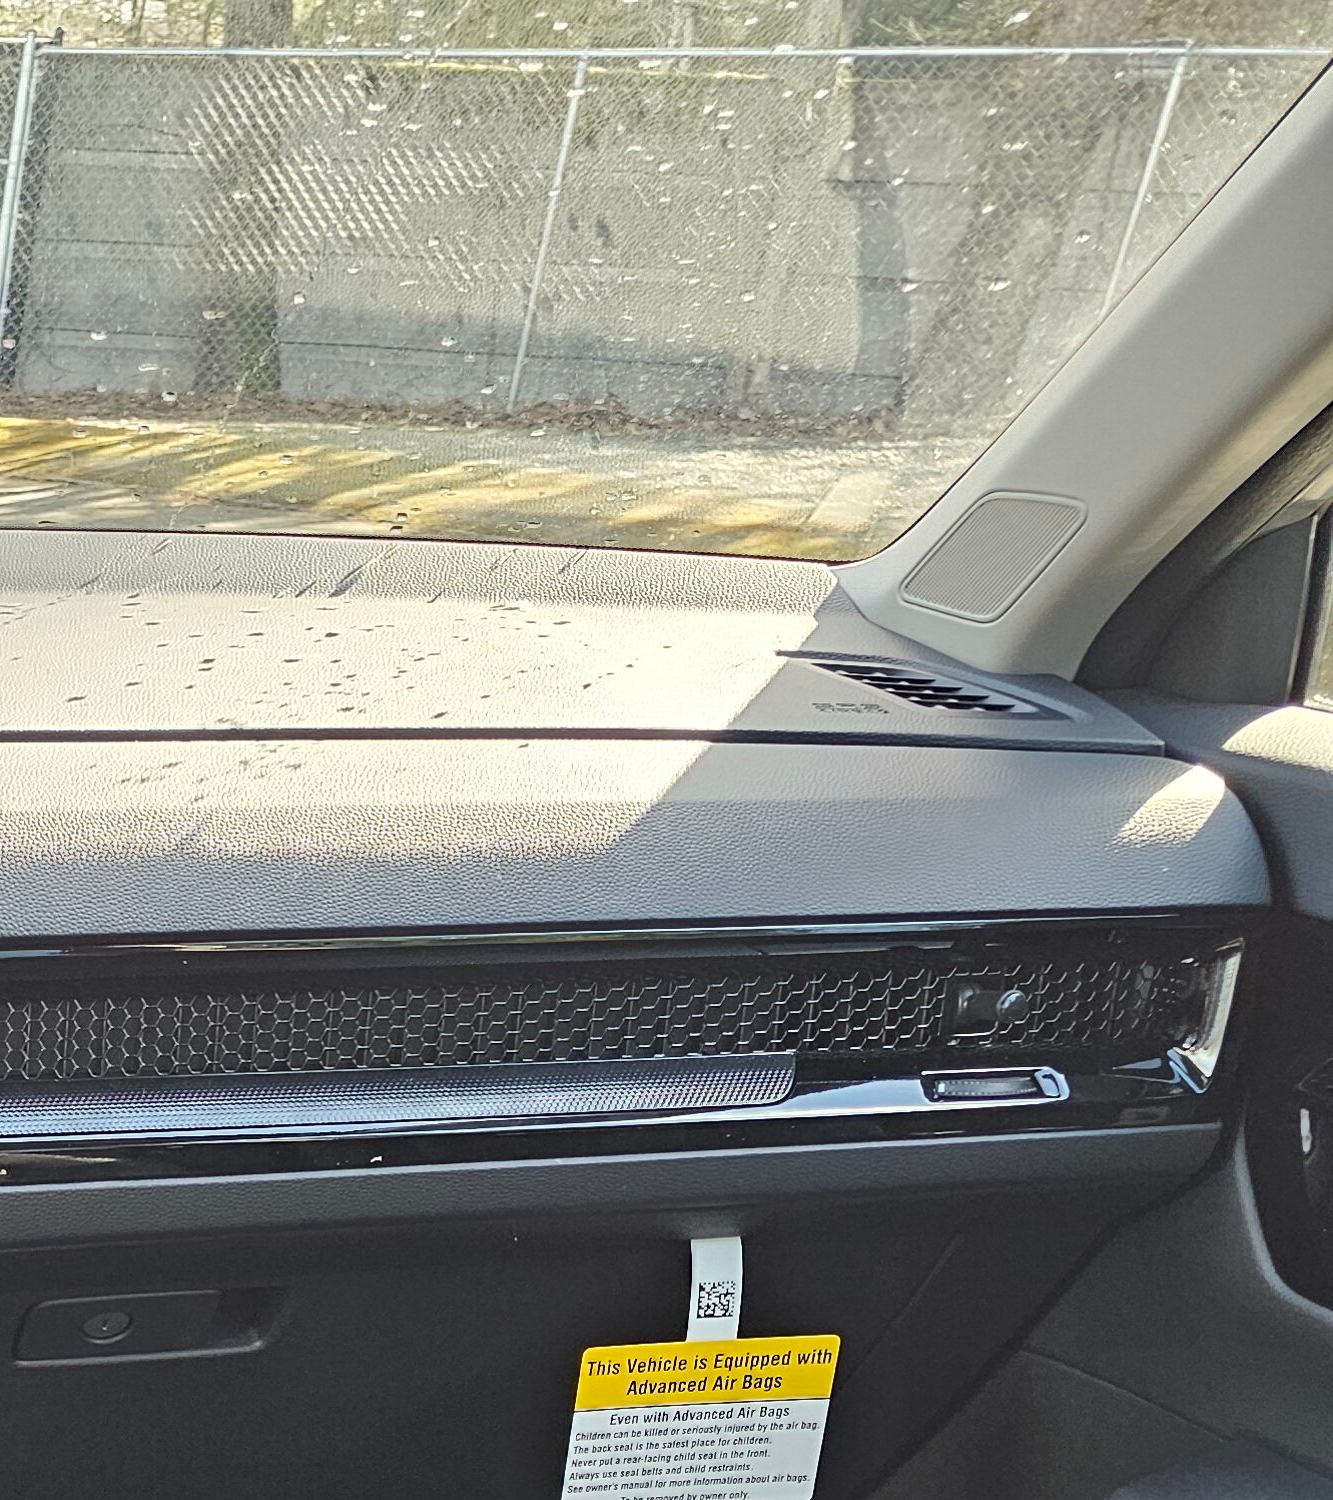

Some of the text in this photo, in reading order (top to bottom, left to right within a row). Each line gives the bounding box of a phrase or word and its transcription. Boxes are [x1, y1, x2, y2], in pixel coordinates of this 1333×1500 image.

[587, 1348, 833, 1377] This Vehicle is Equipped with
[626, 1374, 783, 1396] Advanced Air Bags
[609, 1406, 790, 1426] Even with Advanced Air Bags
[575, 1421, 820, 1442] Children can be killed or seriously injured by the air bag.
[573, 1436, 773, 1455] The back seat is the safest place for children.
[571, 1458, 597, 1468] Never
[599, 1457, 613, 1468] put
[623, 1453, 671, 1465] rear-facing
[674, 1451, 696, 1461] child
[698, 1450, 717, 1460] seat
[719, 1450, 728, 1459] in
[730, 1449, 744, 1459] the
[747, 1448, 771, 1458] front.
[569, 1463, 754, 1481] Always use seat belts and child restraints.
[567, 1473, 811, 1494] See owner's manual for more information about air bags.
[699, 1492, 727, 1500] owner
[729, 1491, 750, 1500] only.
